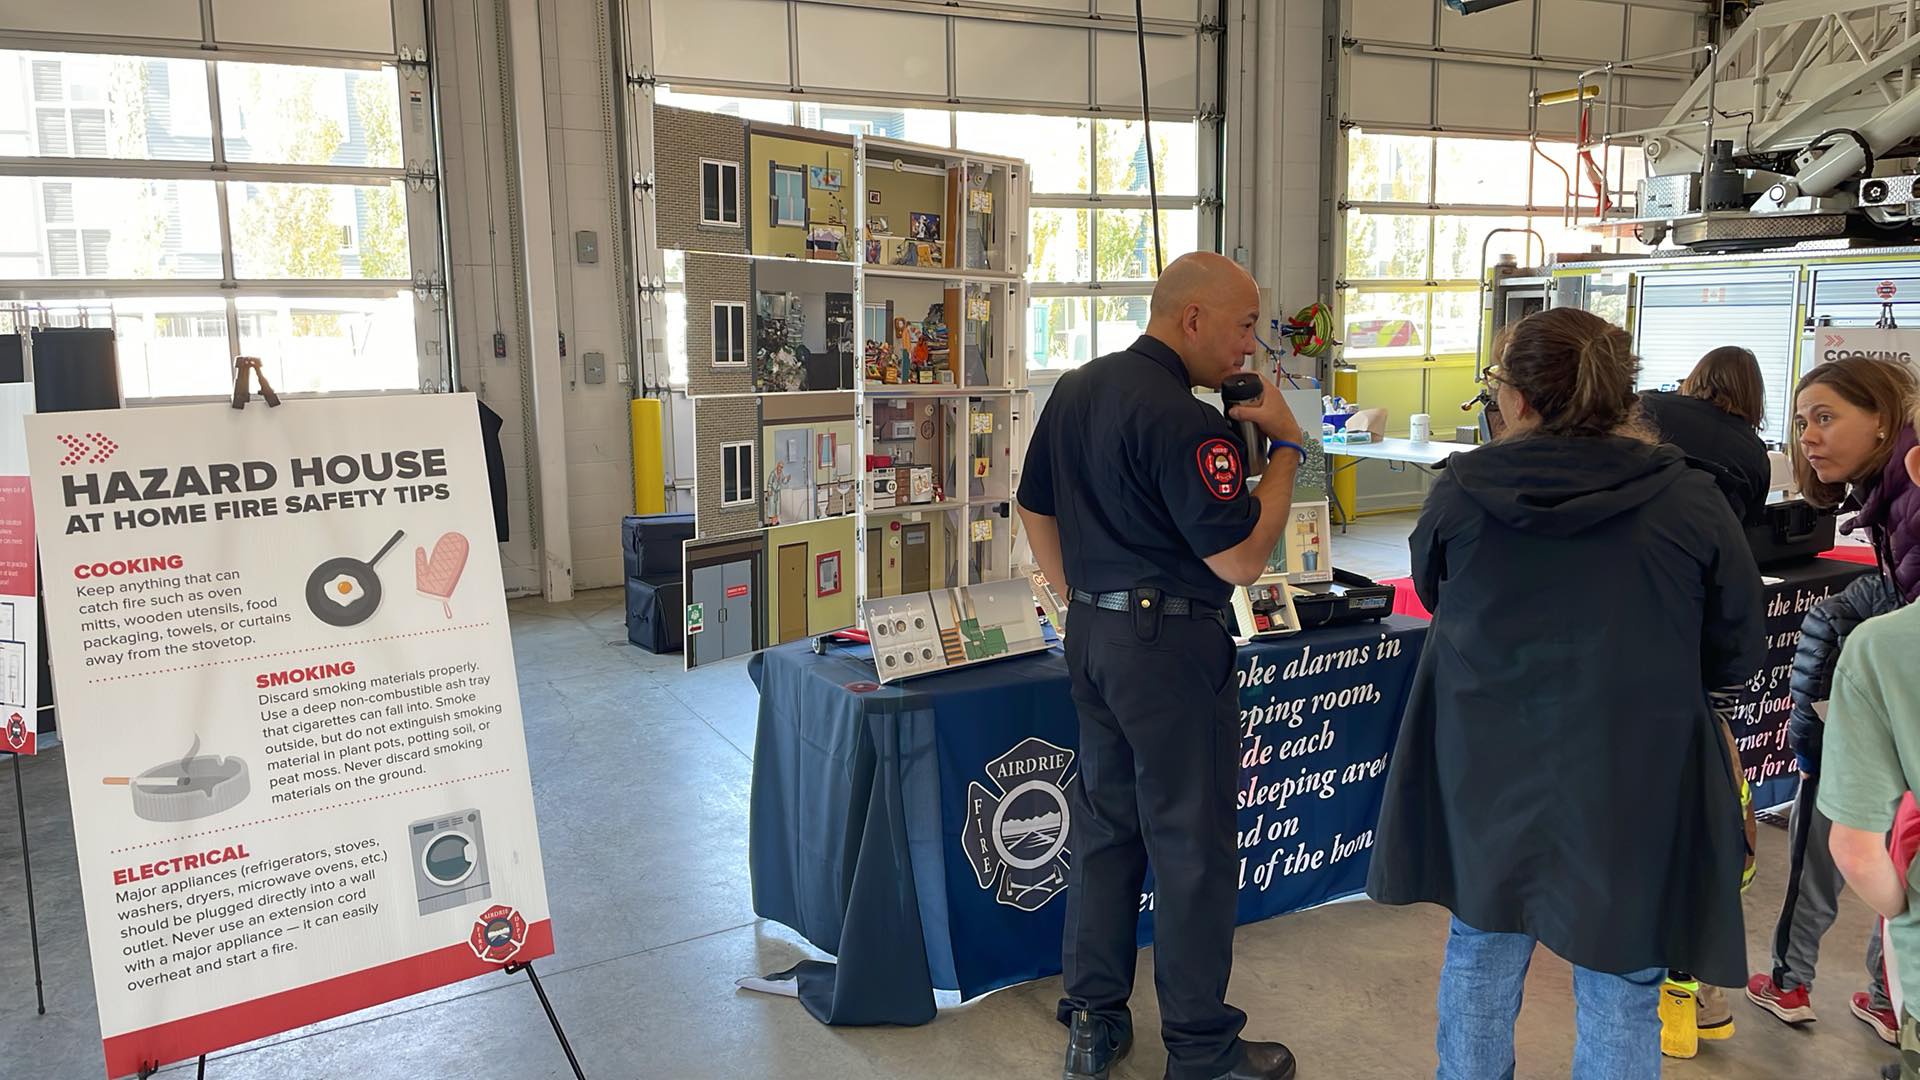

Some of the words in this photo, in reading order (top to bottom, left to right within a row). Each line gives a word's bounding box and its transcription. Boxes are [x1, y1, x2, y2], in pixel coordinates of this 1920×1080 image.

[62, 460, 278, 508] HAZARD
[290, 448, 447, 488] HOUSE
[64, 512, 105, 535] AT
[113, 503, 207, 530] HOME
[213, 497, 278, 521] FIRE
[284, 487, 387, 514] SAFETY
[392, 482, 450, 504] TIPS
[73, 554, 184, 580] COOKING
[76, 584, 115, 598] Keep
[119, 577, 181, 593] anything
[184, 572, 212, 585] that
[215, 570, 240, 582] can
[78, 599, 119, 615] catch
[122, 597, 146, 609] fire
[150, 592, 184, 606] such
[187, 591, 204, 601] as
[207, 586, 242, 599] oven
[80, 618, 120, 632] mitts,
[123, 610, 183, 626] wooden
[186, 602, 244, 618] utensils,
[246, 596, 278, 611] food
[1767, 592, 1791, 617] the
[83, 630, 163, 652] packaging,
[166, 622, 217, 638] towels,
[220, 620, 235, 631] or
[238, 613, 292, 628] curtains
[85, 652, 124, 667] away
[127, 647, 161, 661] from
[164, 643, 188, 656] the
[191, 635, 256, 652] stovetop.
[255, 660, 356, 689] SMOKING
[1283, 645, 1370, 681] alarms
[1377, 632, 1402, 660] in
[258, 687, 309, 706] Discard
[312, 680, 367, 697] smoking
[369, 669, 426, 687] materials
[428, 661, 479, 680] properly.
[260, 709, 288, 722] Use
[290, 707, 299, 717] a
[302, 701, 337, 715] deep
[340, 682, 443, 708] non-combustible
[445, 678, 466, 690] ash
[468, 675, 491, 686] tray
[1312, 683, 1381, 714] room,
[261, 724, 289, 738] that
[292, 714, 357, 734] cigarettes
[359, 709, 382, 721] can
[385, 703, 404, 716] fall
[406, 701, 433, 713] into.
[435, 692, 476, 708] Smoke
[264, 736, 318, 755] outside,
[320, 731, 343, 745] but
[345, 728, 363, 740] do
[365, 723, 387, 736] not
[388, 711, 451, 732] extinguish
[453, 704, 502, 720] smoking
[1775, 719, 1791, 751] if
[267, 750, 320, 771] material
[323, 749, 336, 761] in
[338, 742, 371, 760] plant
[373, 737, 405, 753] pots,
[407, 729, 450, 747] potting
[452, 722, 476, 736] soil,
[478, 721, 490, 731] or
[269, 772, 300, 790] peat
[302, 766, 341, 781] moss.
[343, 757, 382, 773] Never
[385, 746, 430, 765] discard
[433, 738, 483, 755] smoking
[997, 753, 1065, 778] AIRDRIE
[1241, 735, 1273, 769] de
[1279, 719, 1335, 760] each
[271, 783, 332, 804] materials
[334, 780, 352, 791] on
[354, 775, 375, 787] the
[378, 763, 426, 785] ground.
[1236, 767, 1337, 810] sleeping
[1755, 754, 1785, 787] for
[974, 799, 992, 873] FIRE
[1267, 816, 1299, 841] on
[112, 843, 250, 886] ELECTRICAL
[115, 886, 157, 904] Major
[160, 868, 237, 895] appliances
[240, 848, 331, 878] (refrigerators,
[334, 837, 380, 855] stoves,
[117, 899, 183, 921] washers,
[185, 887, 234, 906] dryers,
[237, 869, 311, 894] microwave
[314, 859, 358, 876] ovens,
[360, 849, 388, 865] etc.)
[1253, 848, 1284, 891] of
[1283, 842, 1325, 876] the
[120, 916, 169, 939] should
[172, 914, 192, 927] be
[195, 897, 254, 924] plugged
[257, 886, 307, 906] directly
[310, 880, 335, 894] into
[338, 878, 347, 887] a
[349, 868, 376, 884] wall
[122, 936, 168, 956] outlet.
[171, 925, 215, 945] Never
[218, 919, 244, 933] use
[248, 914, 265, 926] an
[268, 897, 334, 921] extension
[337, 887, 367, 904] cord
[124, 957, 155, 974] with
[159, 955, 168, 966] a
[171, 944, 212, 962] major
[216, 927, 283, 952] appliance
[302, 918, 312, 930] it
[314, 913, 339, 927] can
[342, 902, 379, 920] easily
[127, 966, 192, 991] overheat
[195, 957, 222, 975] and
[225, 949, 257, 967] start
[260, 948, 269, 958] a
[271, 942, 298, 955] fire.
